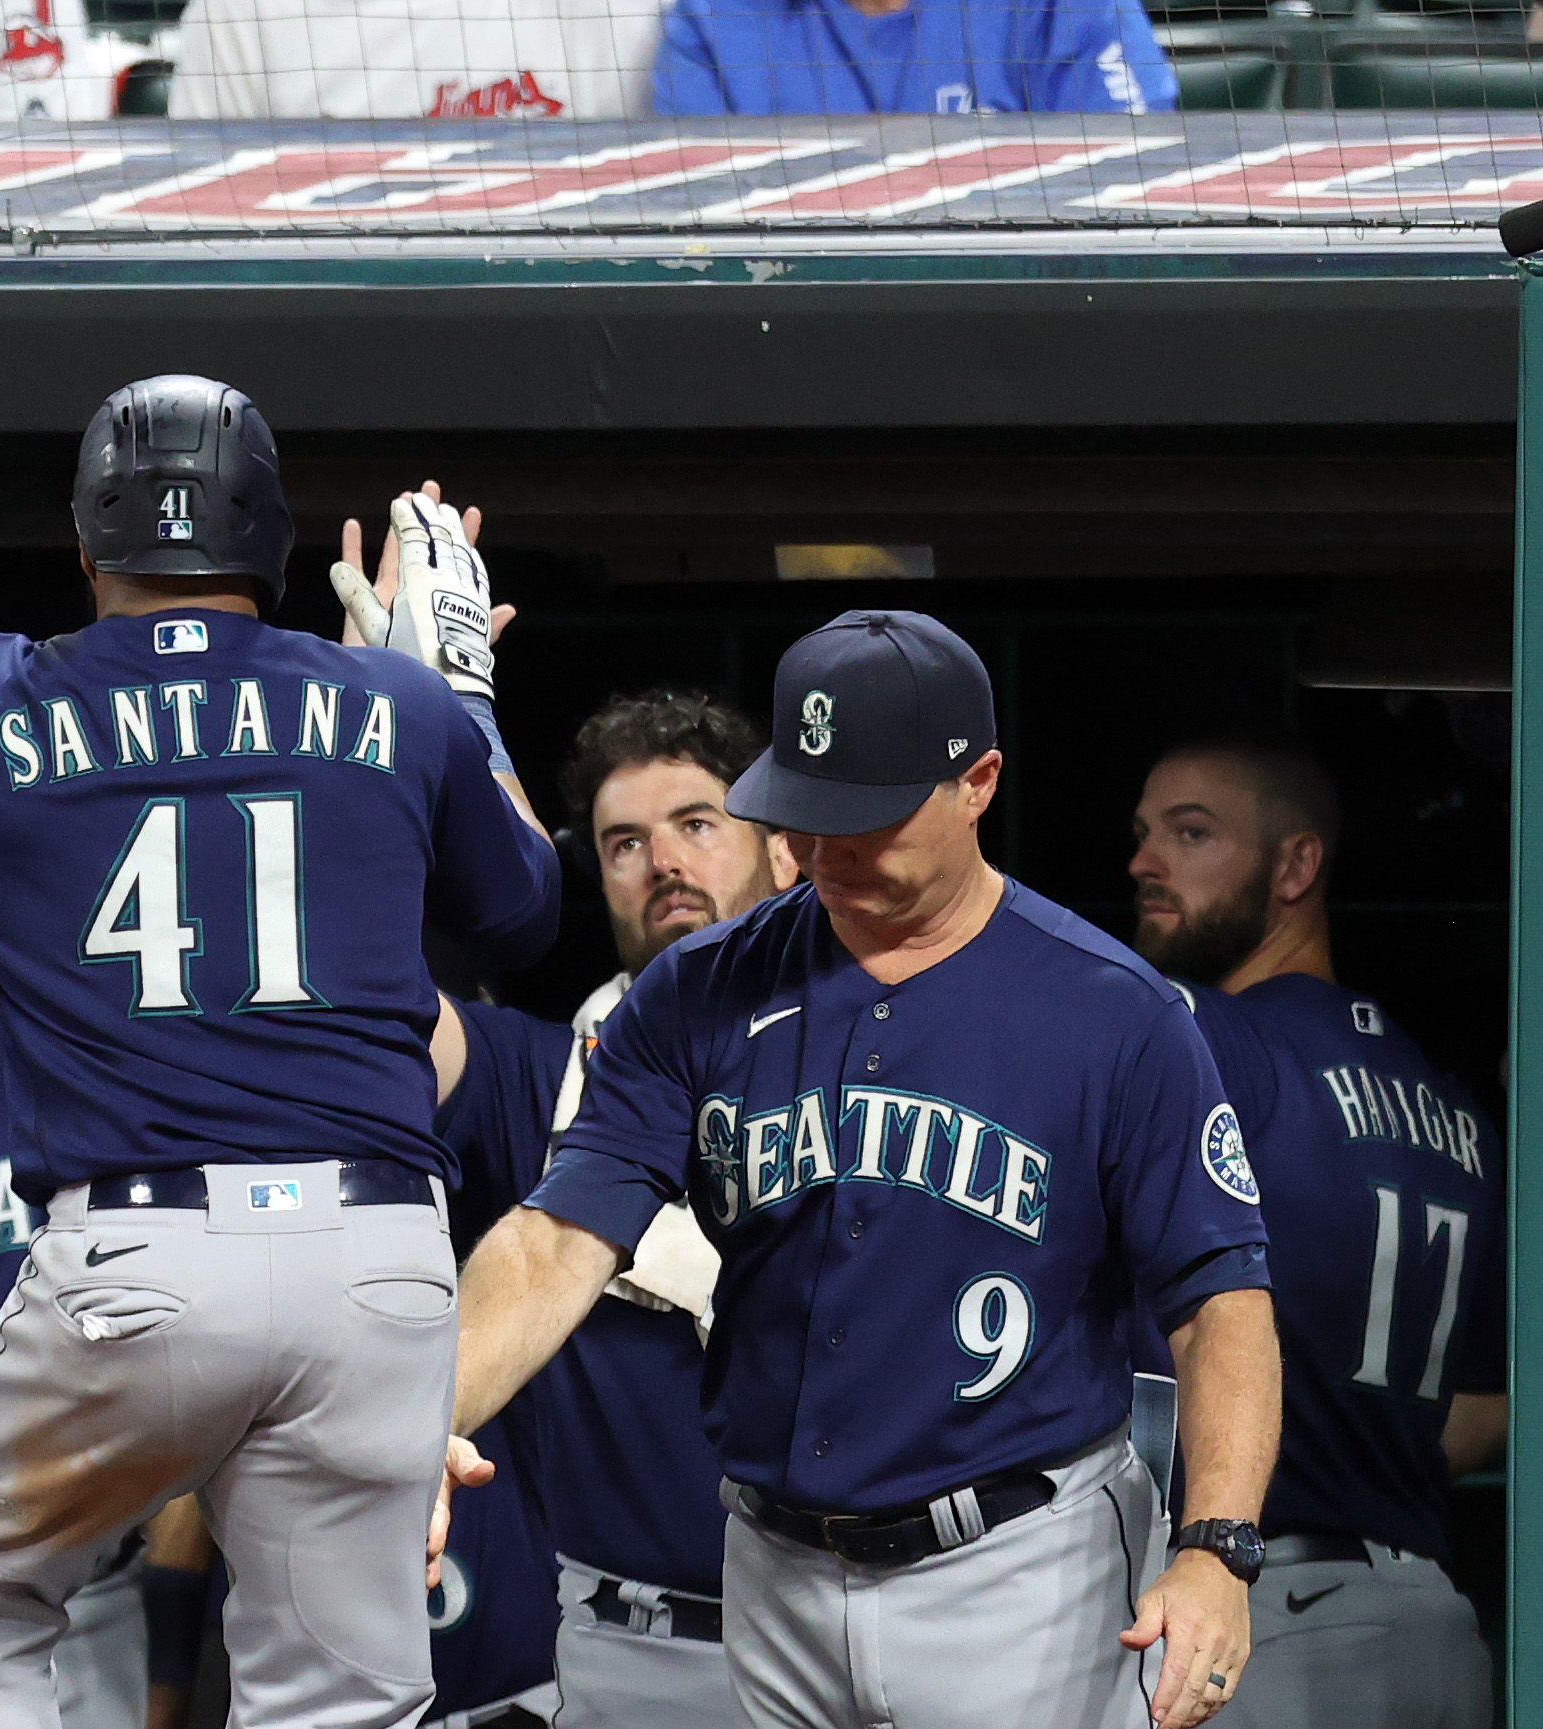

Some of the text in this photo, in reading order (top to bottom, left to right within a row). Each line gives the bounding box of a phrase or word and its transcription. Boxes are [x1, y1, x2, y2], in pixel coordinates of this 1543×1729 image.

[159, 487, 189, 519] 41
[799, 689, 837, 757] S
[79, 792, 332, 1018] 41
[696, 1085, 1052, 1246] SEATTLE
[952, 1270, 1036, 1403] 9
[1351, 1184, 1470, 1400] 17
